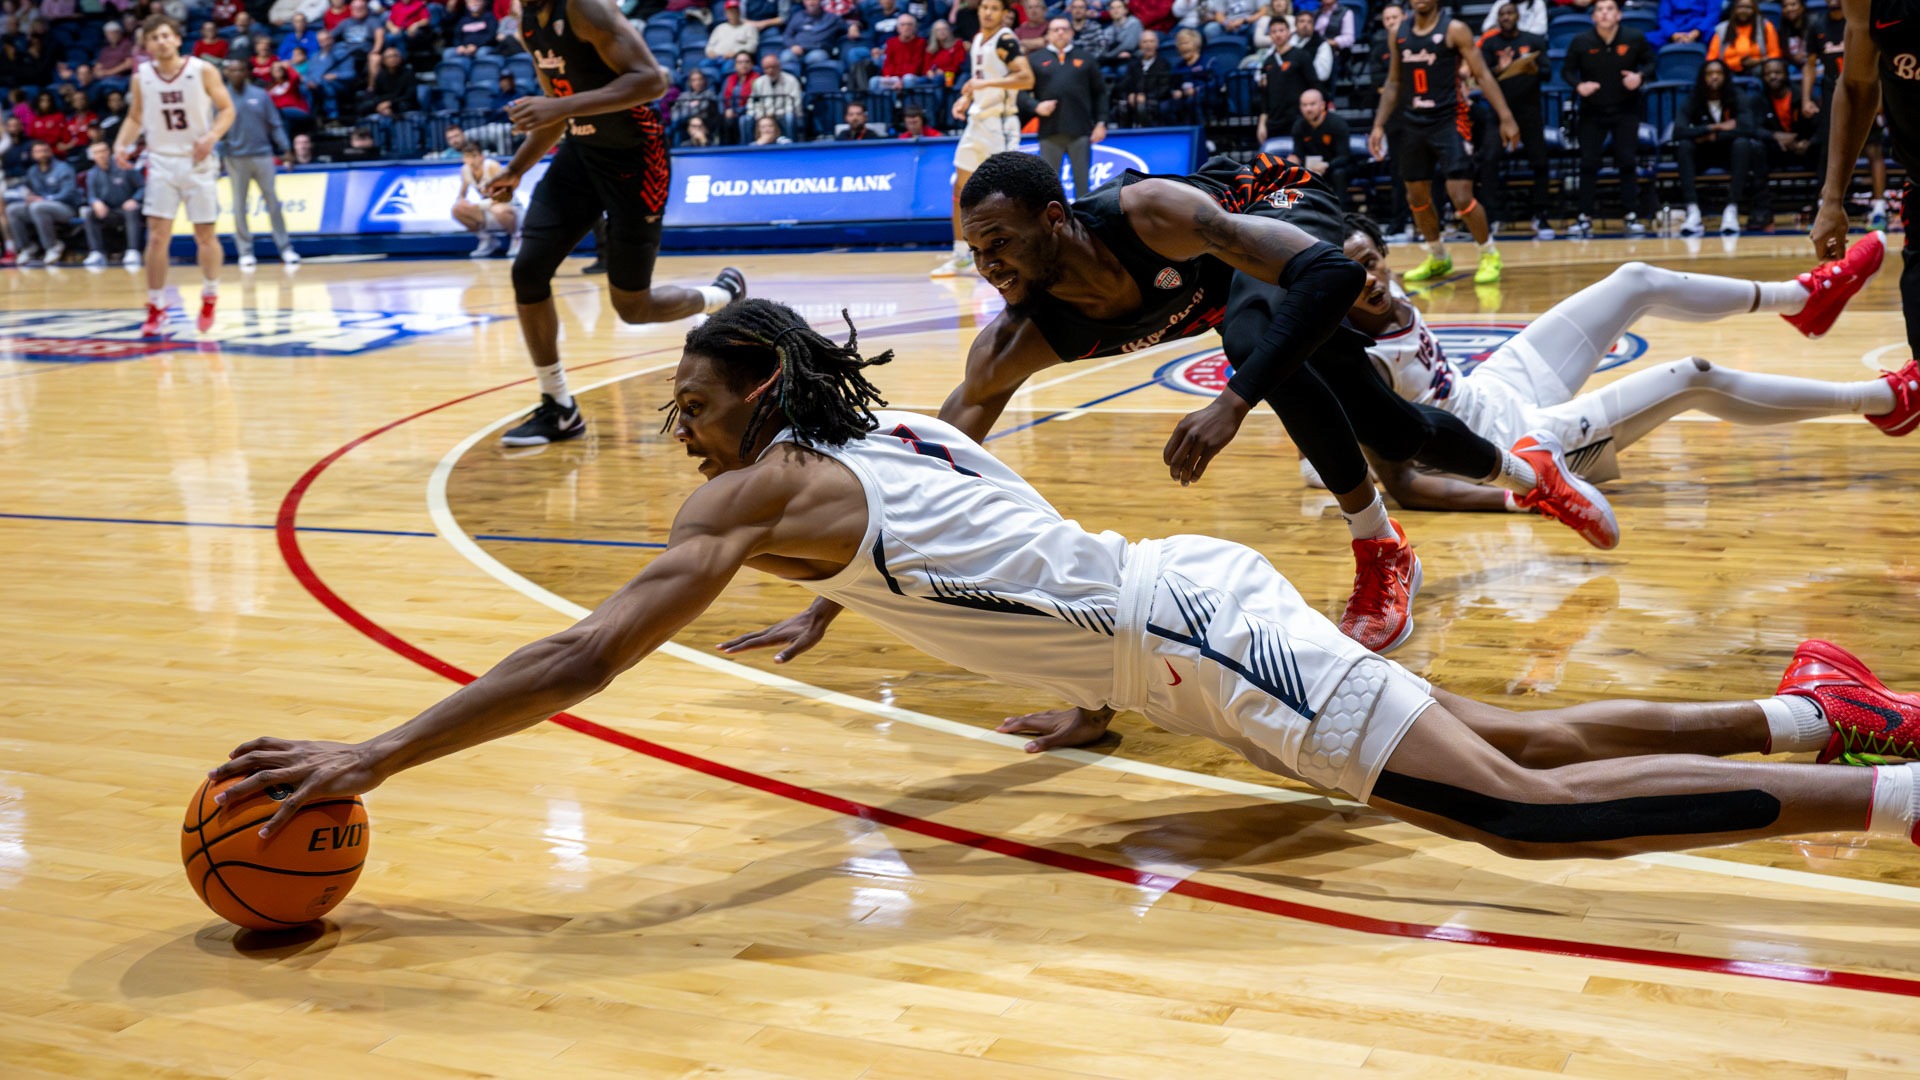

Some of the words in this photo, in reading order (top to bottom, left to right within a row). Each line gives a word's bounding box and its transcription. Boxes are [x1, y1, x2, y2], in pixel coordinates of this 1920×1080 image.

[1413, 68, 1429, 94] 0
[160, 91, 183, 104] USI
[161, 108, 188, 131] 13
[710, 180, 749, 196] OLD
[750, 176, 838, 195] NATIONAL
[841, 174, 893, 191] BANK
[307, 823, 362, 852] EVO
